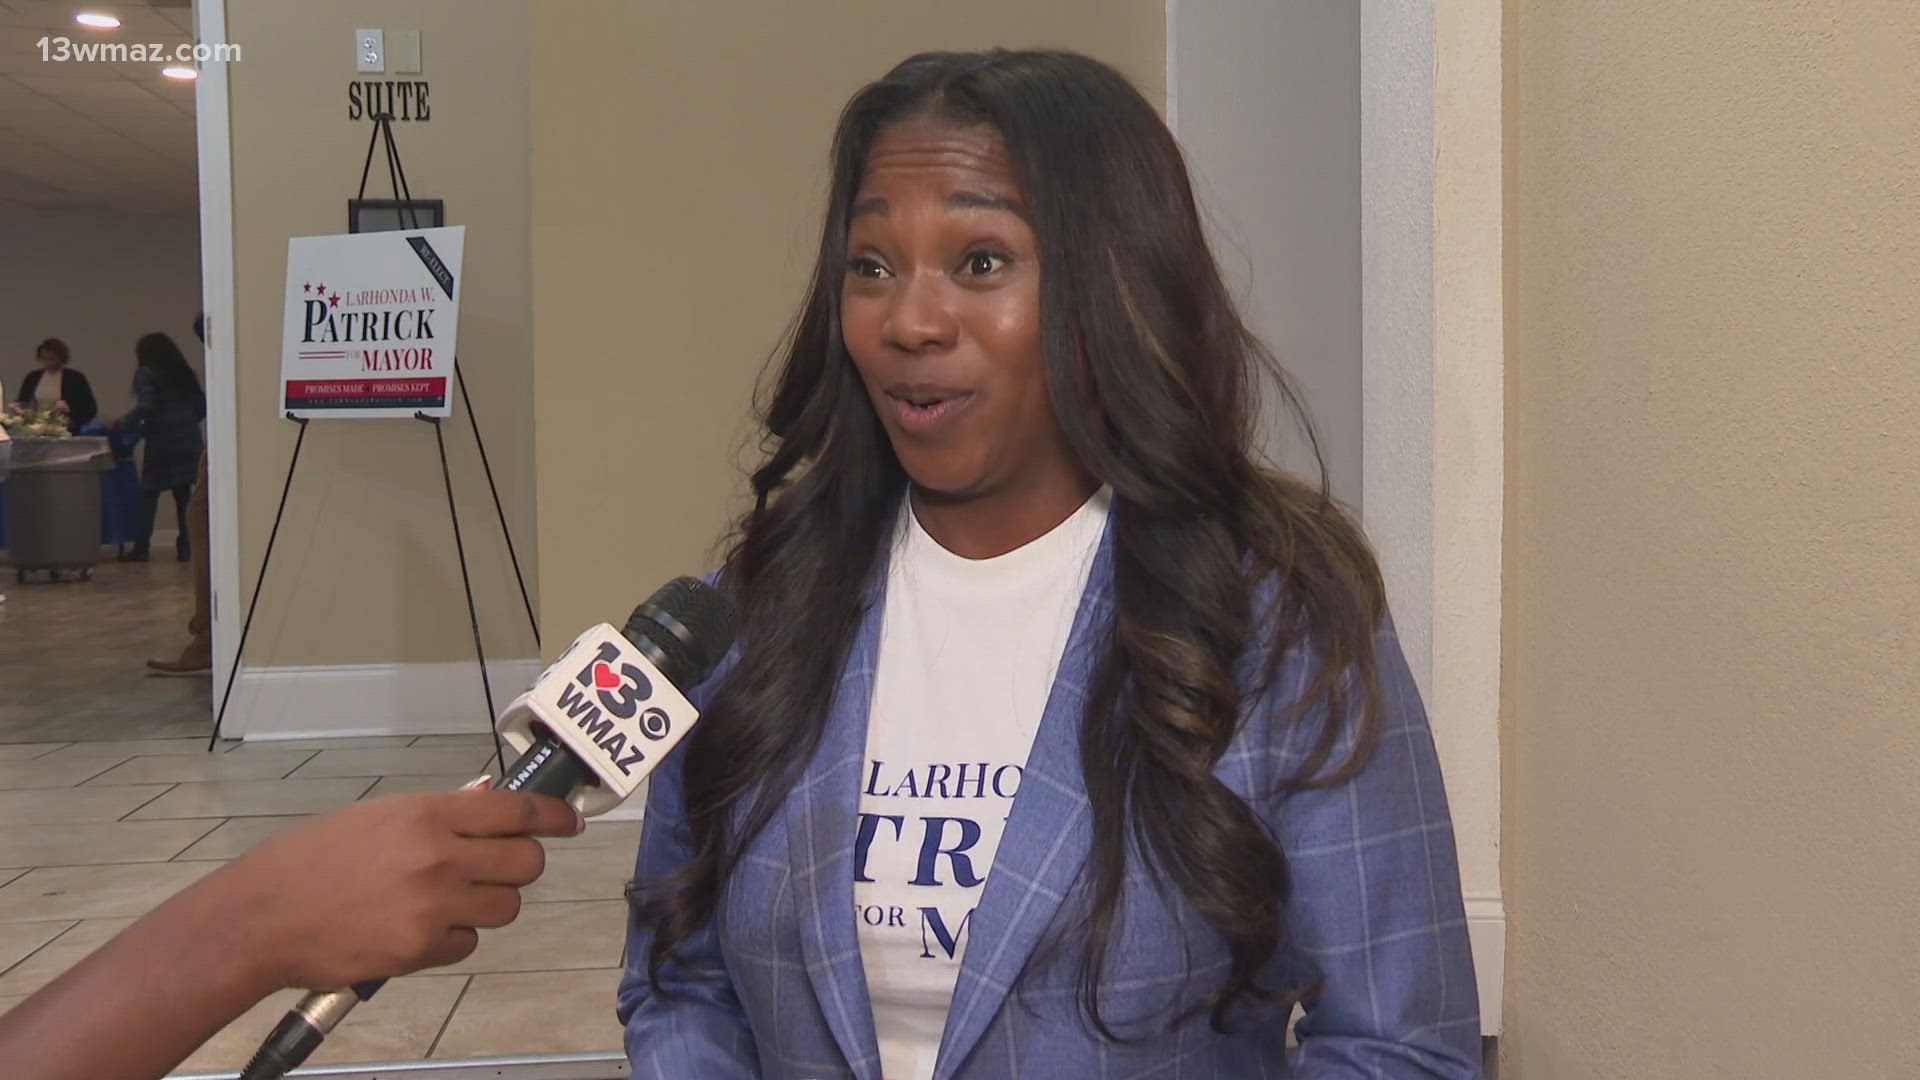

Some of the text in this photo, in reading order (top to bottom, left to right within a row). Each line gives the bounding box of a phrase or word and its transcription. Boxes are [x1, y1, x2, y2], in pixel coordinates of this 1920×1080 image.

[349, 81, 431, 121] SUITE
[345, 287, 435, 306] LARHONDA W.
[302, 299, 434, 343] PATRICK
[362, 347, 433, 372] MAYOR
[305, 382, 430, 394] PROMISES MADE PROMISES KEPT
[576, 641, 654, 719] 13
[557, 682, 645, 776] WMAZ
[863, 759, 1025, 799] LARHO
[854, 813, 1009, 888] TR
